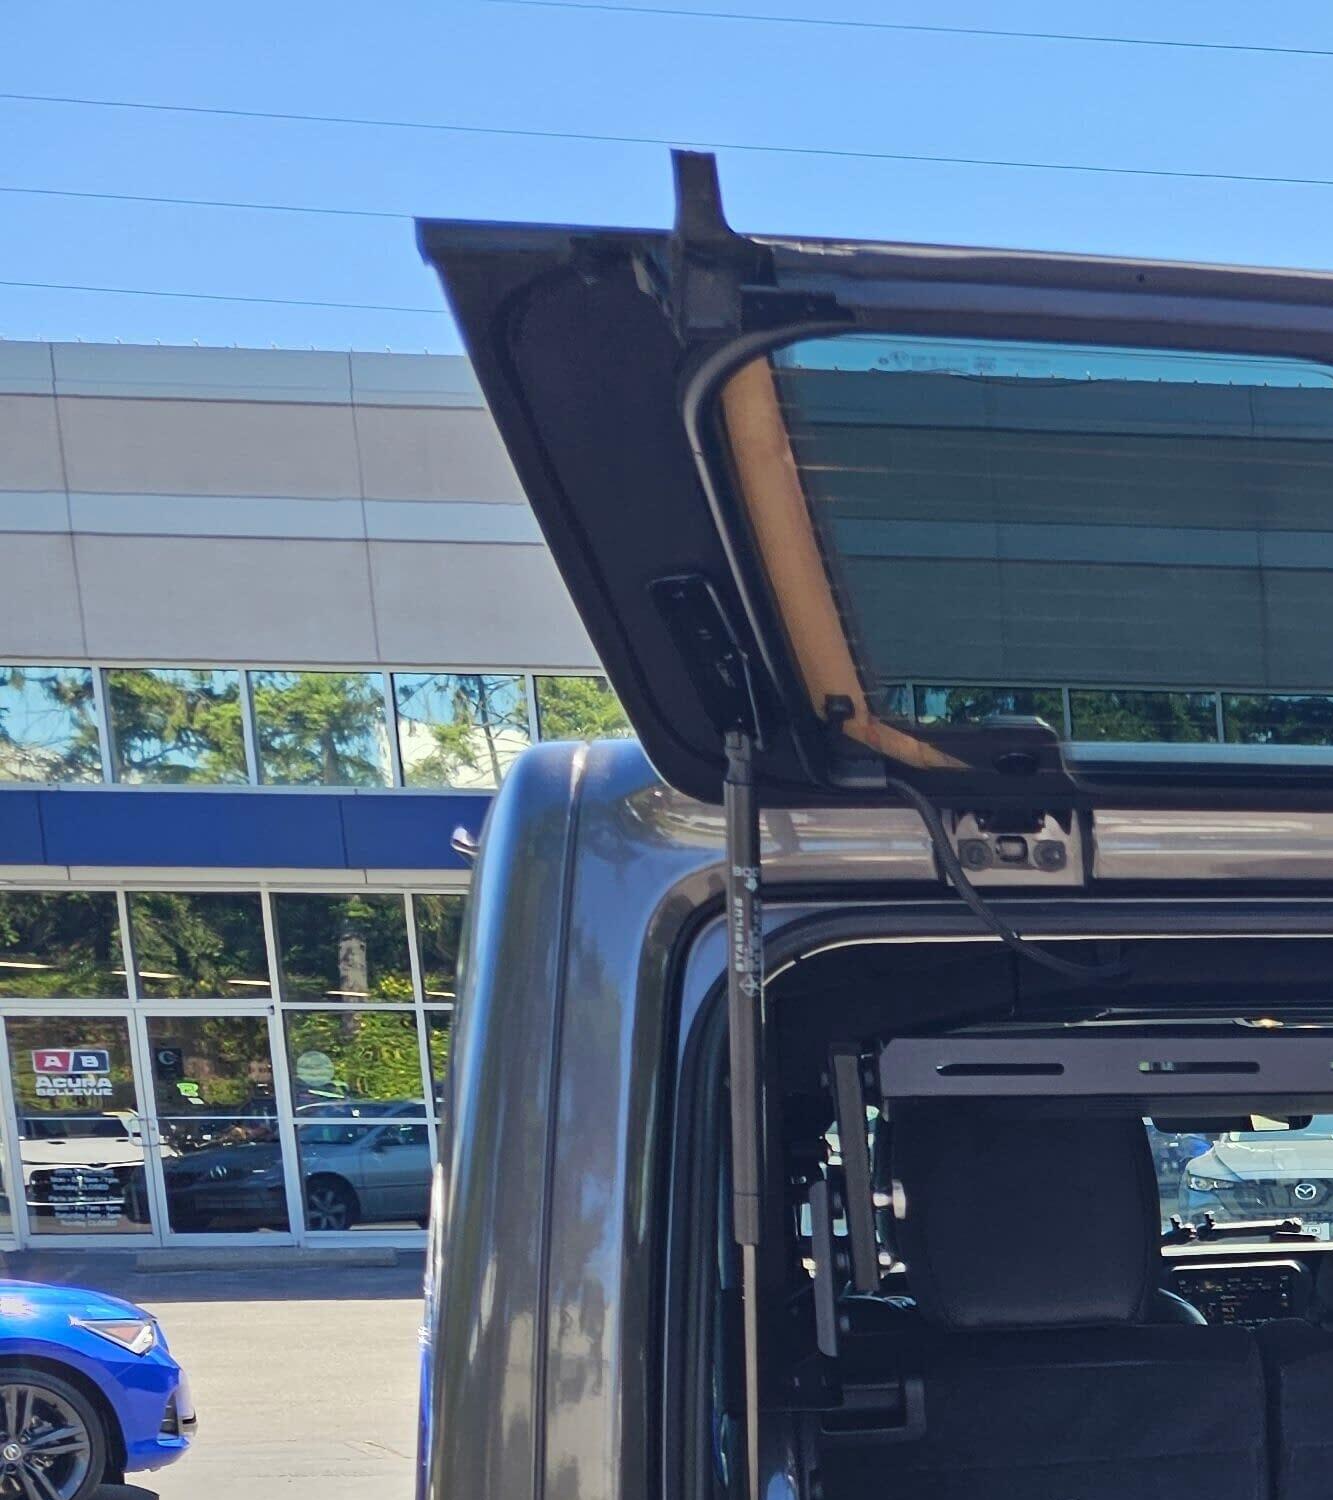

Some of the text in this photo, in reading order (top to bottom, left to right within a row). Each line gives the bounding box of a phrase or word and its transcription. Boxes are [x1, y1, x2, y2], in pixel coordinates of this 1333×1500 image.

[44, 1056, 99, 1067] A B
[35, 1076, 112, 1088] ACURA
[36, 1088, 113, 1096] BELLEVUE
